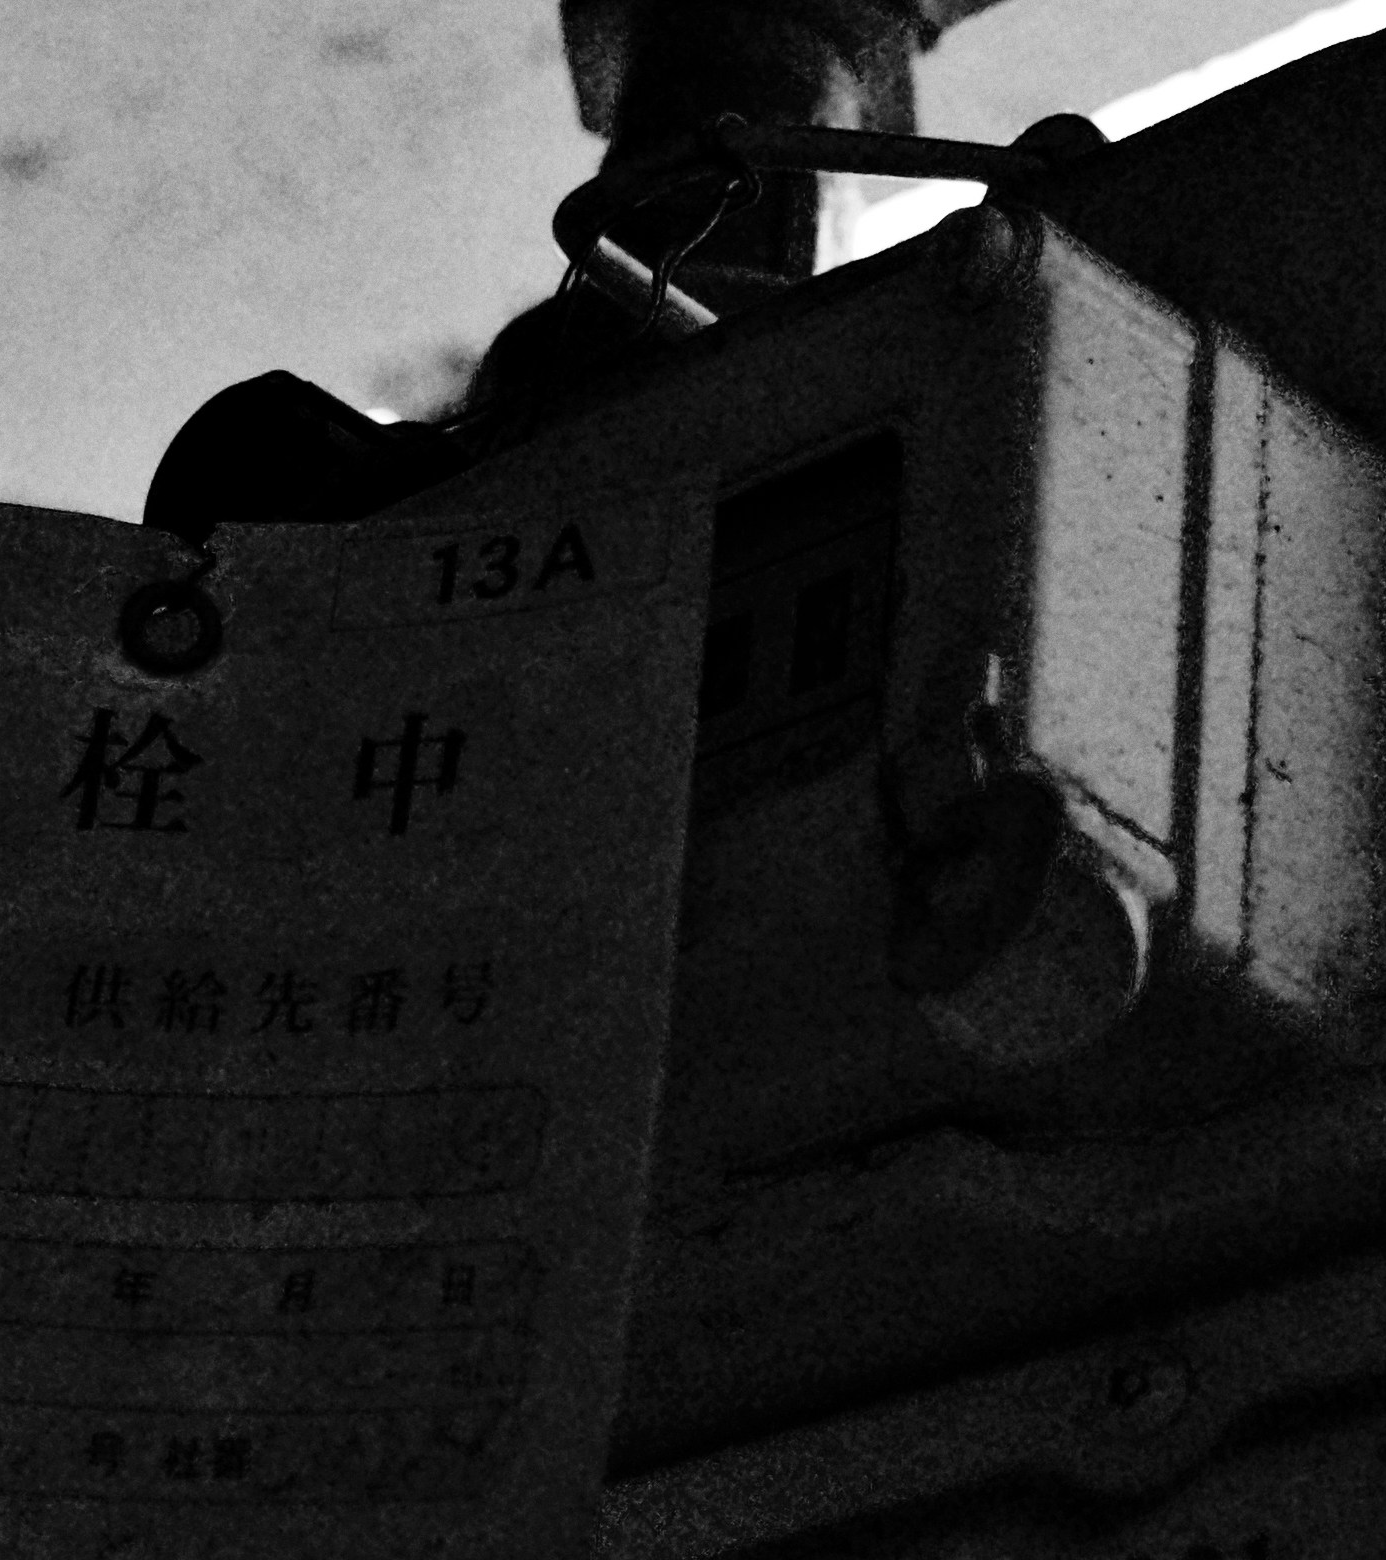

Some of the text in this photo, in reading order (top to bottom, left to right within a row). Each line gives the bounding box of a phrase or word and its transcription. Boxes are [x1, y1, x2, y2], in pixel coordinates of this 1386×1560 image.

[433, 522, 595, 605] 13A
[62, 960, 495, 1034] 供給先番号
